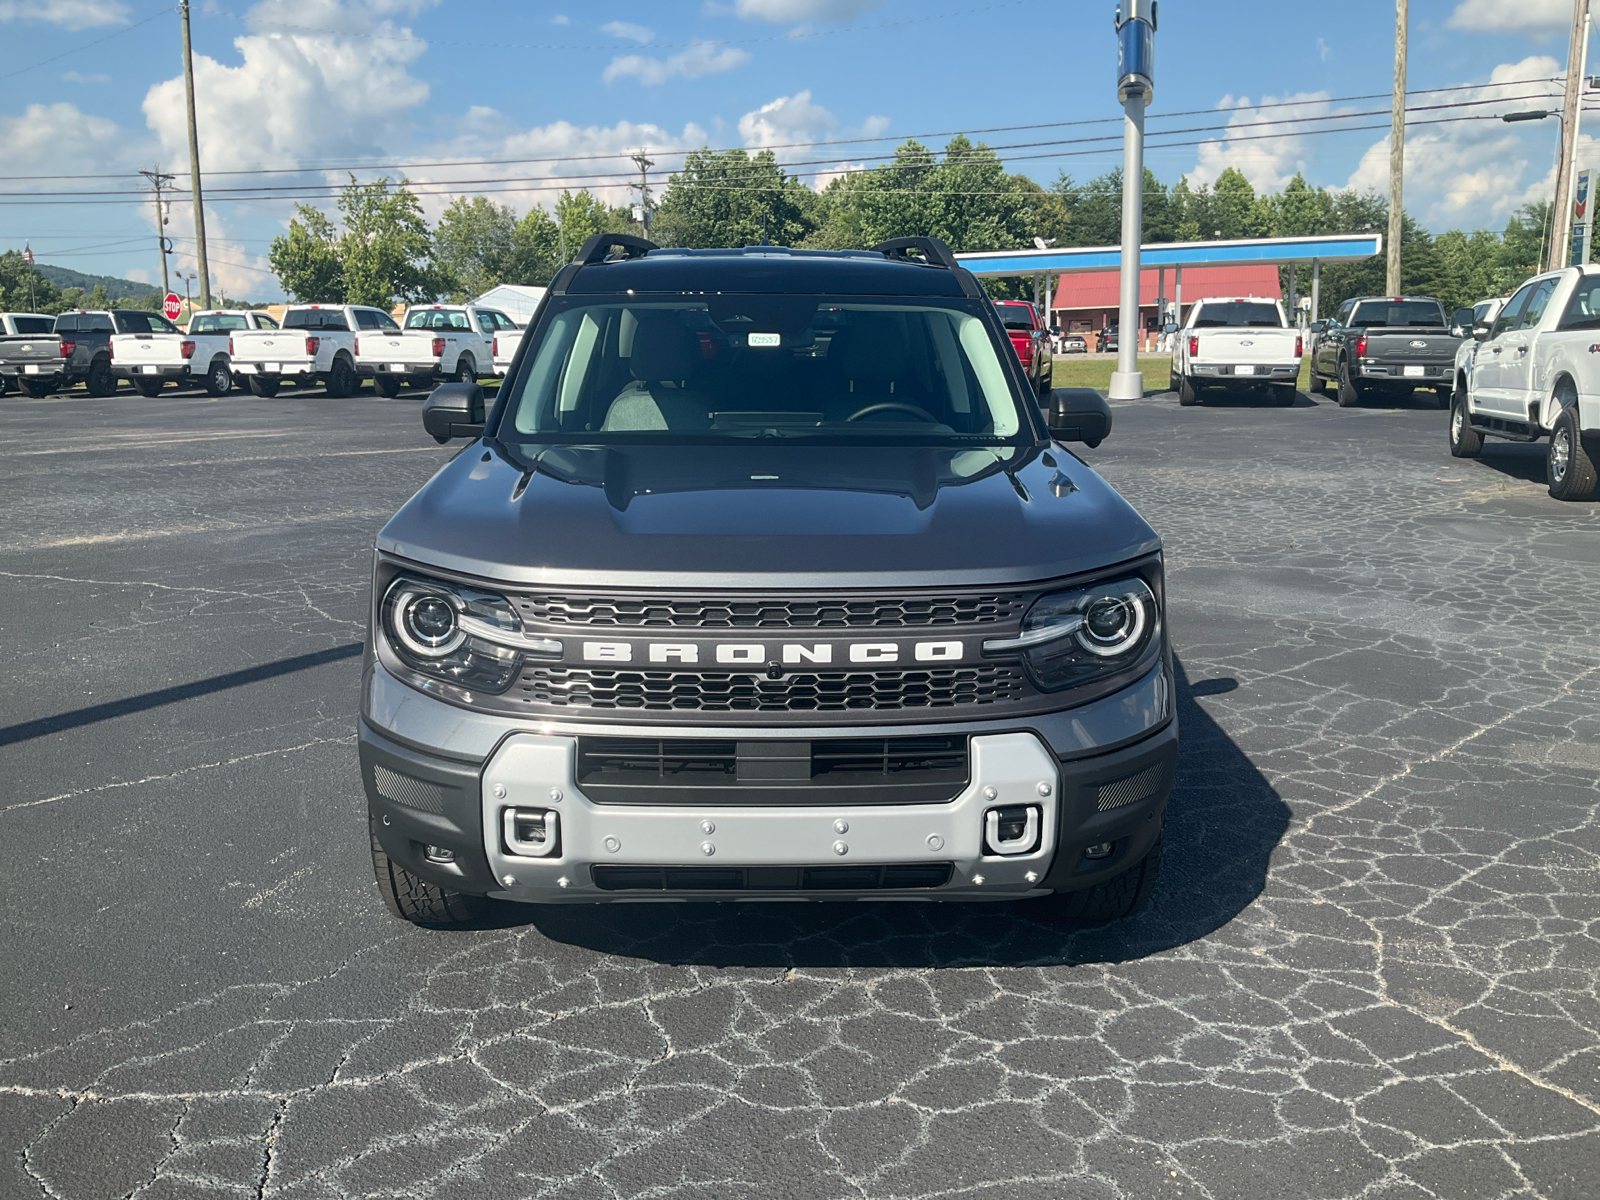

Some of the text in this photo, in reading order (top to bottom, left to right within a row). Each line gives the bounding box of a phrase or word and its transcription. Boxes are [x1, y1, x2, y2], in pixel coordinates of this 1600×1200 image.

[164, 301, 180, 313] STOP
[1384, 348, 1450, 356] F-150
[583, 640, 964, 664] BRONCO
